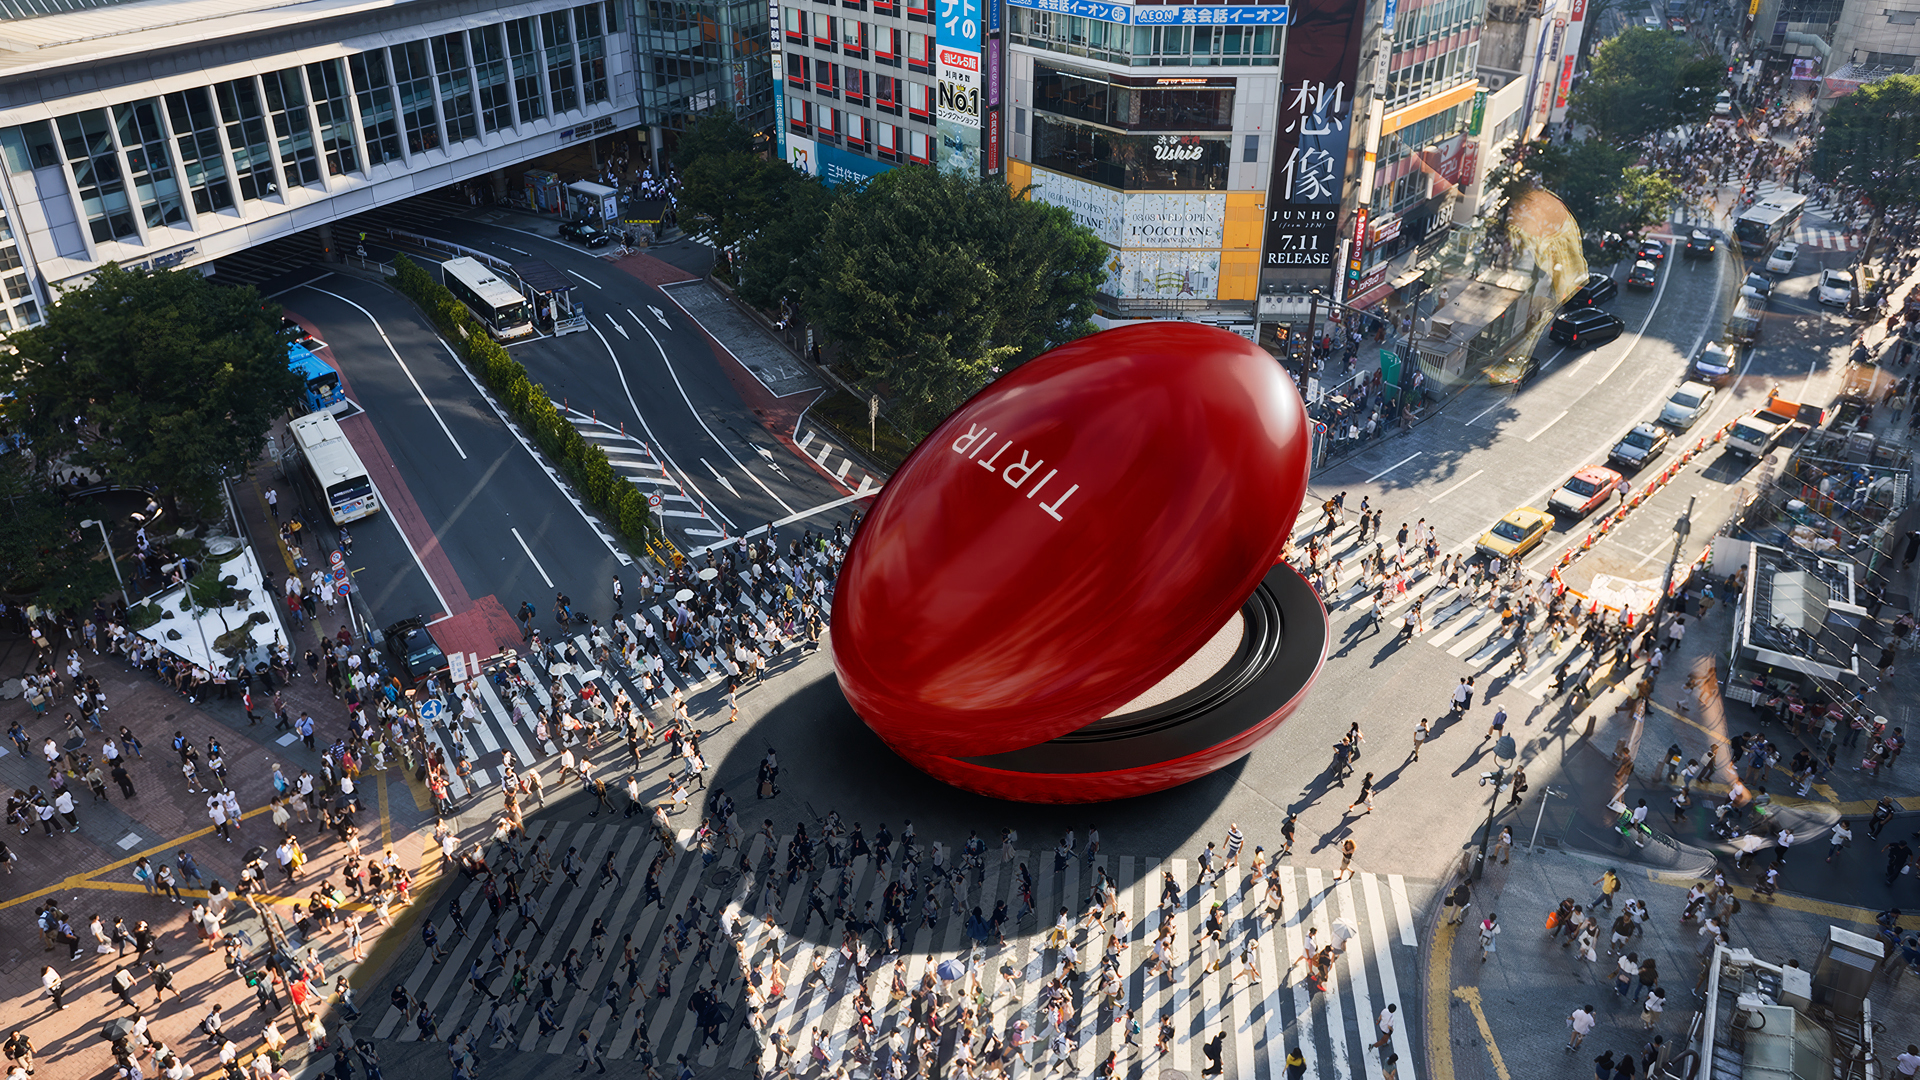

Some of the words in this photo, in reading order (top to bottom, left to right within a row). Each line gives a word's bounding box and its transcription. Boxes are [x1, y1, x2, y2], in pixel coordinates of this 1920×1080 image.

[1112, 8, 1126, 21] 6F
[1139, 9, 1174, 22] AEON
[1181, 7, 1286, 24] 英会話イーオン
[938, 79, 979, 117] No.1
[1280, 79, 1345, 201] 想像
[1083, 202, 1105, 216] OPEN
[1272, 210, 1335, 222] JUNHO
[1185, 213, 1214, 222] OPEN
[1426, 203, 1453, 234] LUSH
[1132, 224, 1213, 236] L'OCCITANE
[1281, 235, 1318, 250] 7.11
[1268, 252, 1330, 265] RELEASE
[952, 423, 1080, 522] TIRTIR
